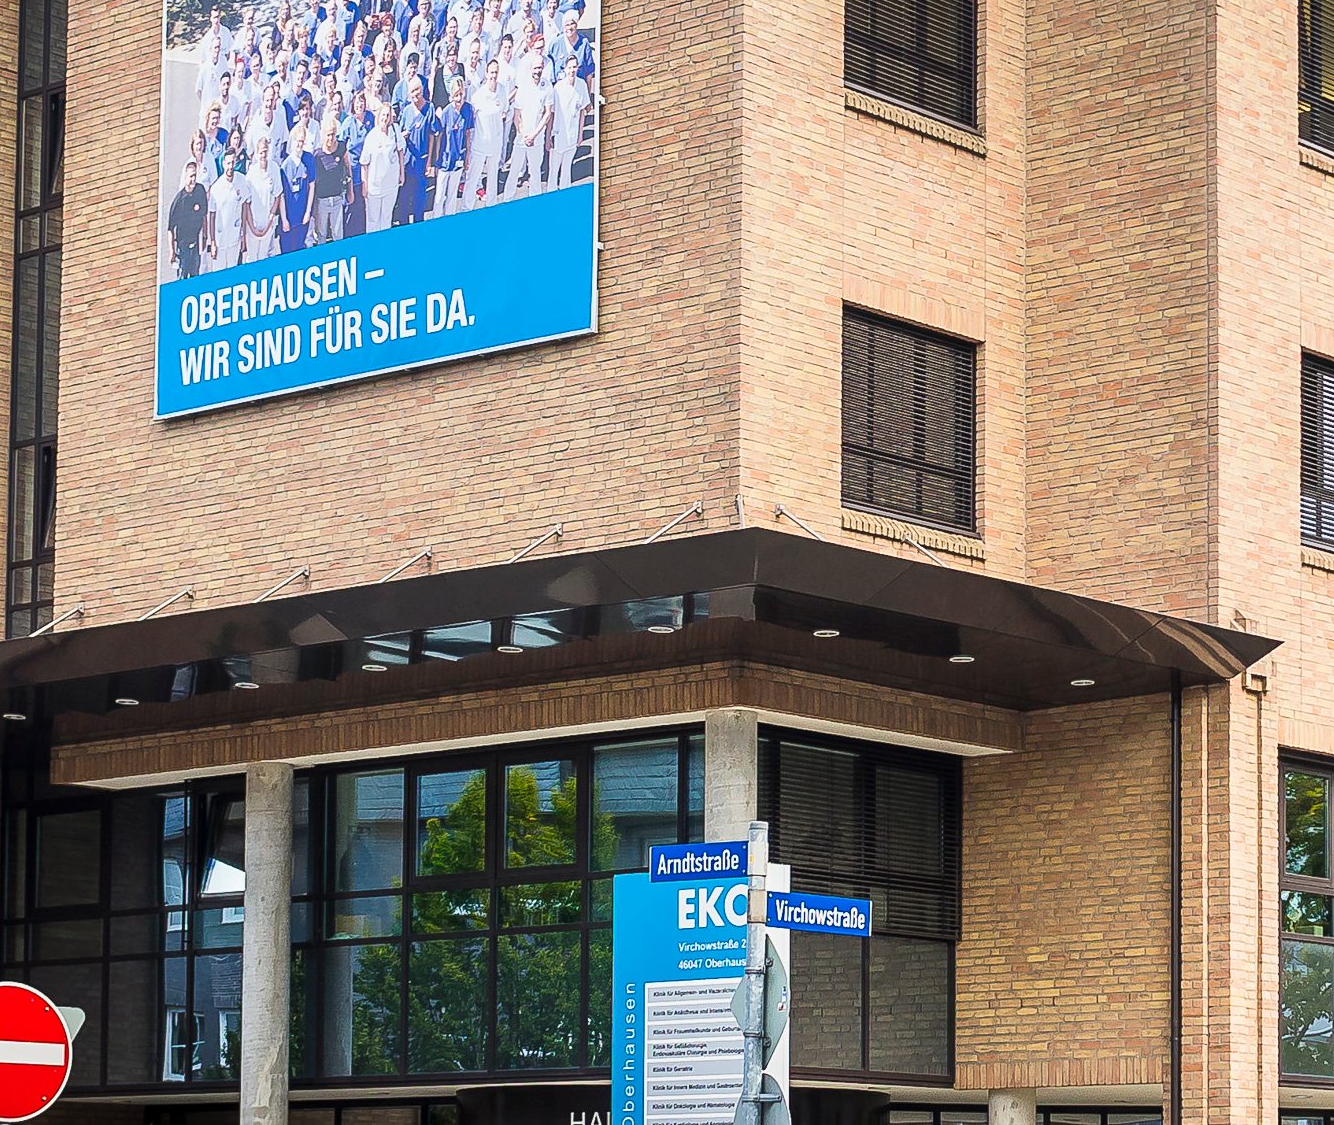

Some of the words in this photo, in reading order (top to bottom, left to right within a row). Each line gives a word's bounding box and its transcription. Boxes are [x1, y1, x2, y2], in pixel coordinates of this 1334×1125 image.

[180, 256, 357, 335] OBERHAUSEN
[179, 340, 229, 386] WIR
[237, 324, 301, 375] SIND
[310, 306, 363, 359] FÜR
[370, 298, 417, 345] SIE
[426, 289, 476, 335] DA.
[657, 849, 740, 875] Arndtstraße
[775, 898, 866, 930] Virchowstraße
[678, 940, 739, 953] Virchowstraße
[678, 958, 703, 970] 46047
[705, 957, 747, 968] Oberhaus
